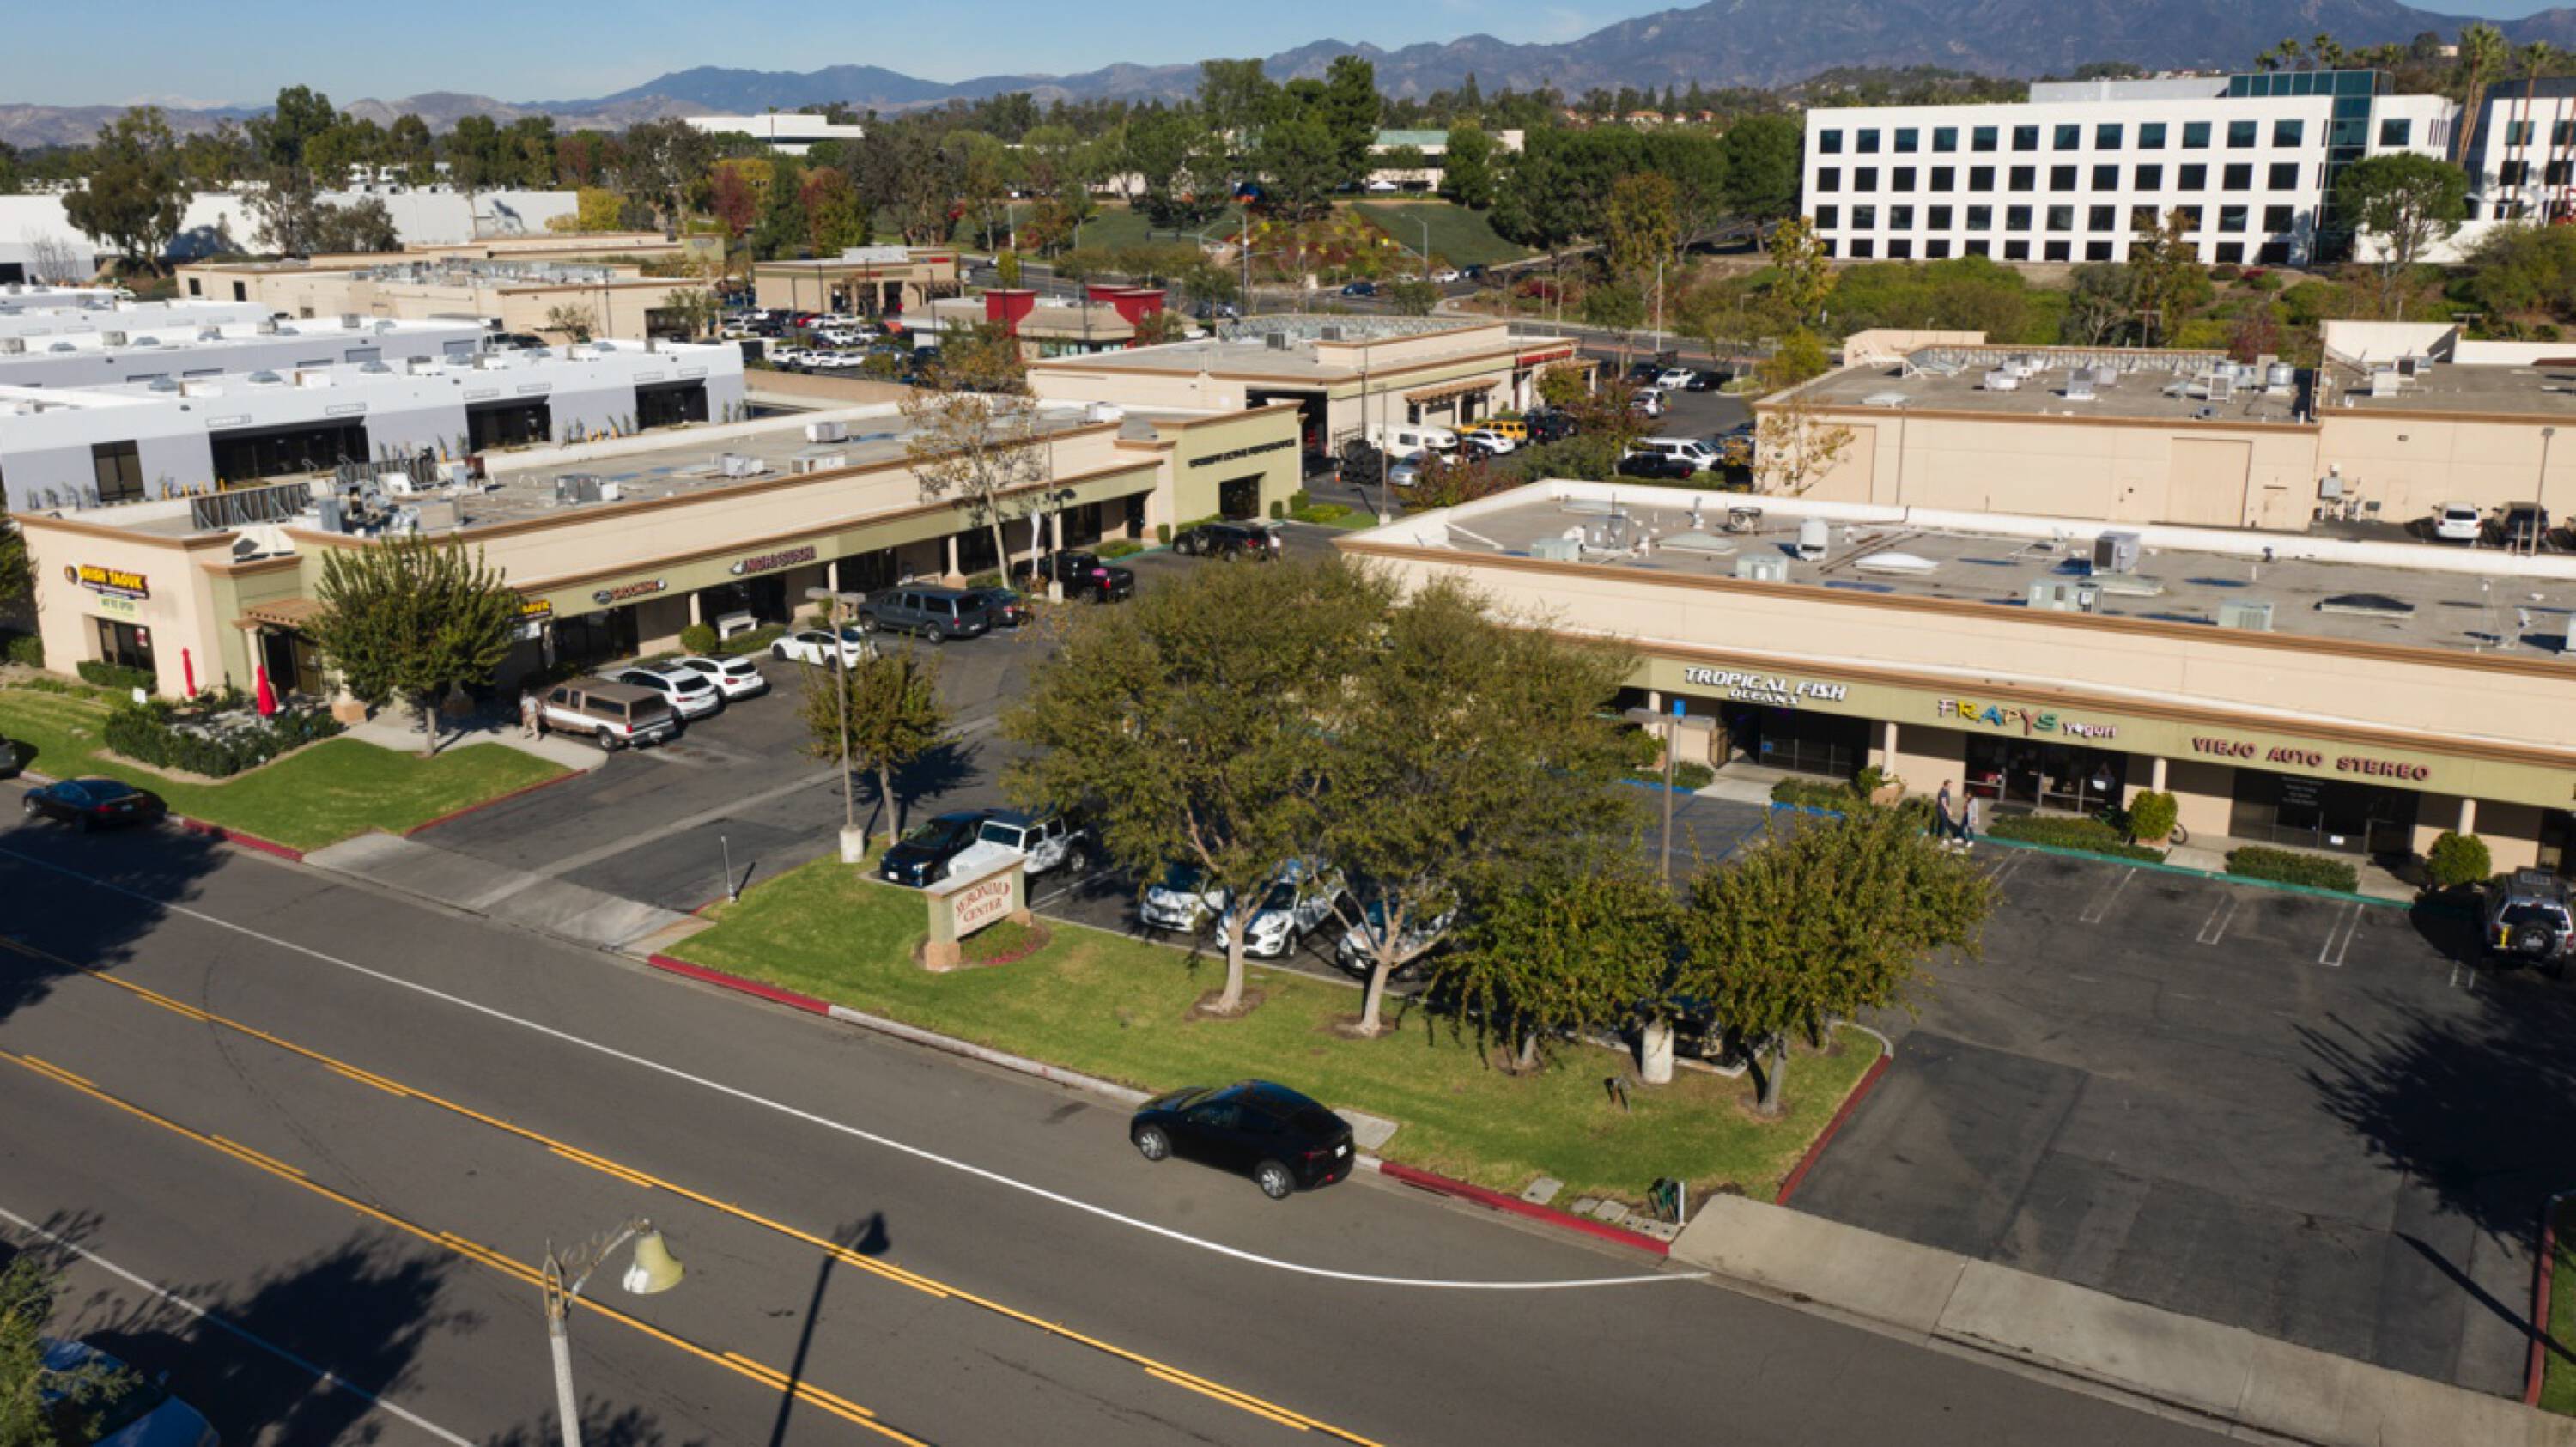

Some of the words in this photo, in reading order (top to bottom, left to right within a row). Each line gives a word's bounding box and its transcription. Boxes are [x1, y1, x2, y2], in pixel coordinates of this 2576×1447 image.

[1686, 666, 1789, 692] TROPICAL
[1795, 679, 1848, 702] FISH
[1729, 688, 1800, 706] OCEANS
[1938, 699, 2058, 736] FRAPYS
[2192, 736, 2257, 759] VIEJO
[2267, 746, 2324, 768] AUTO
[2336, 756, 2432, 781] STEREO
[963, 897, 1003, 922] CENTER
